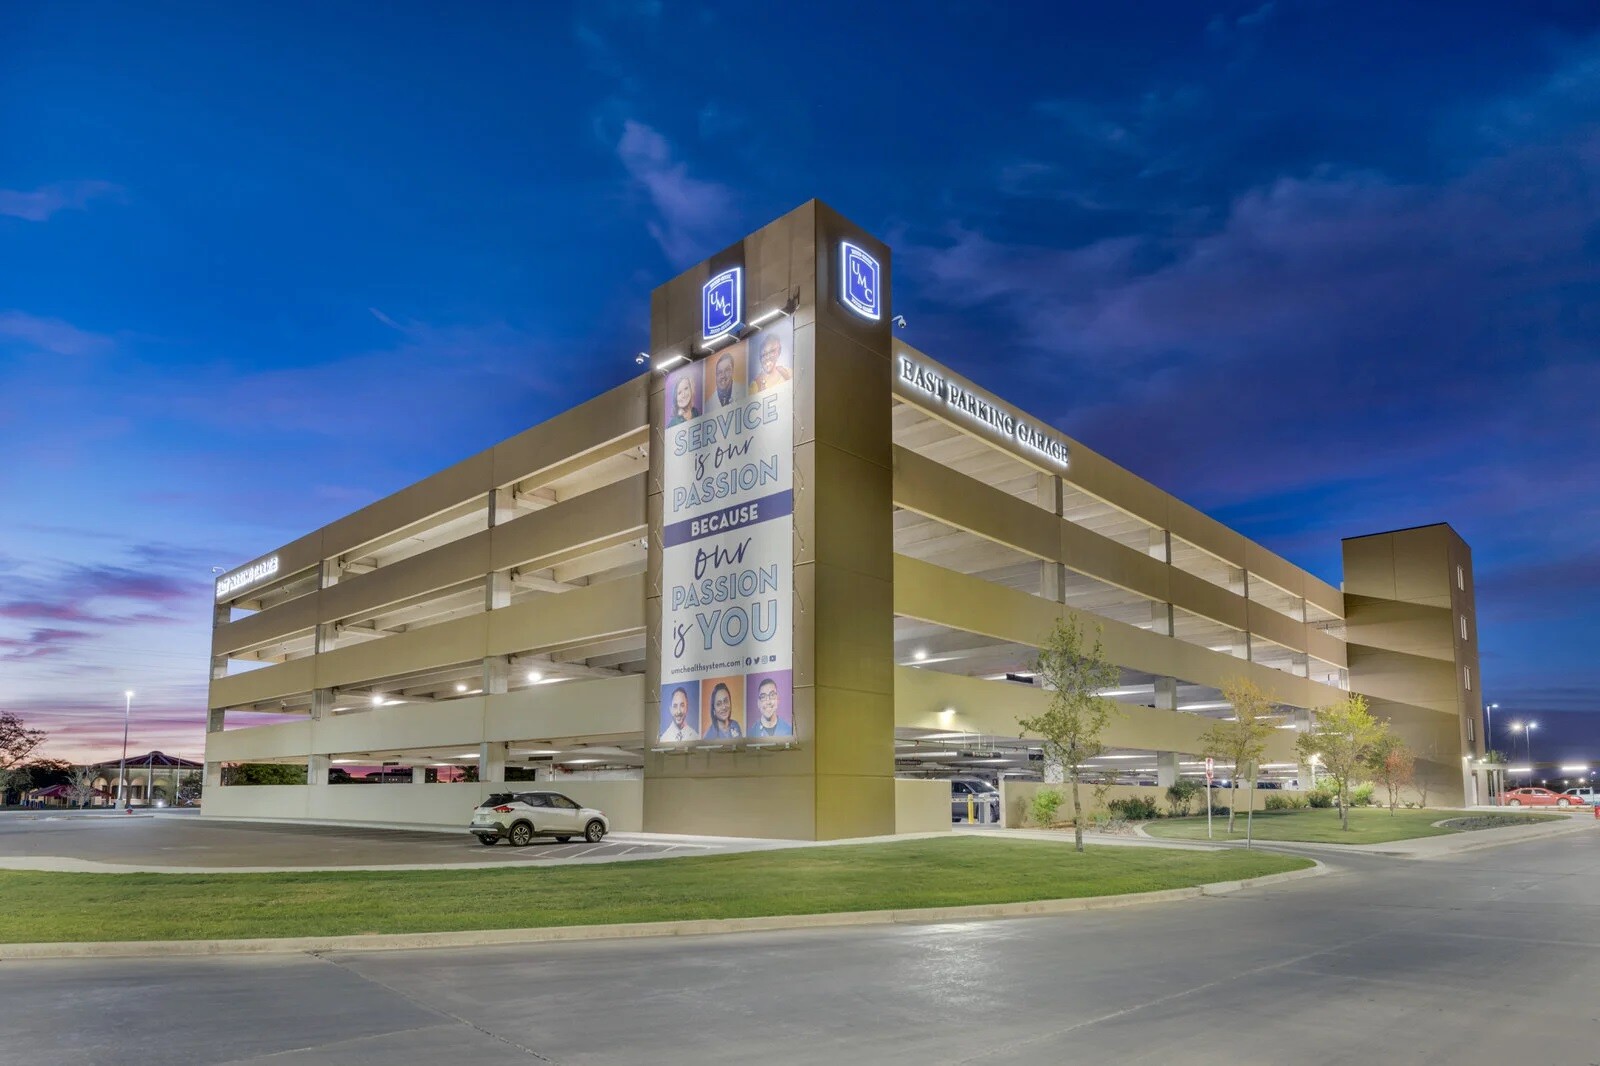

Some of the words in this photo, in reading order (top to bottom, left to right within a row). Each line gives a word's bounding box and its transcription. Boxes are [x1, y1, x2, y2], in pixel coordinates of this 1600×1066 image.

[710, 291, 731, 317] UMC
[852, 260, 873, 302] UMC
[673, 393, 779, 457] SERVICE
[902, 358, 944, 397] EAST
[949, 384, 1015, 435] PARKING
[1018, 423, 1069, 464] GARAGE
[694, 452, 710, 481] is
[714, 435, 754, 469] our
[673, 454, 778, 513] PASSION
[691, 503, 759, 537] BECAUSE
[694, 537, 752, 580] our
[671, 564, 778, 611] PASSION
[673, 620, 694, 658] is
[696, 600, 778, 650] YOU
[671, 659, 741, 674] umchealthsystem.com
